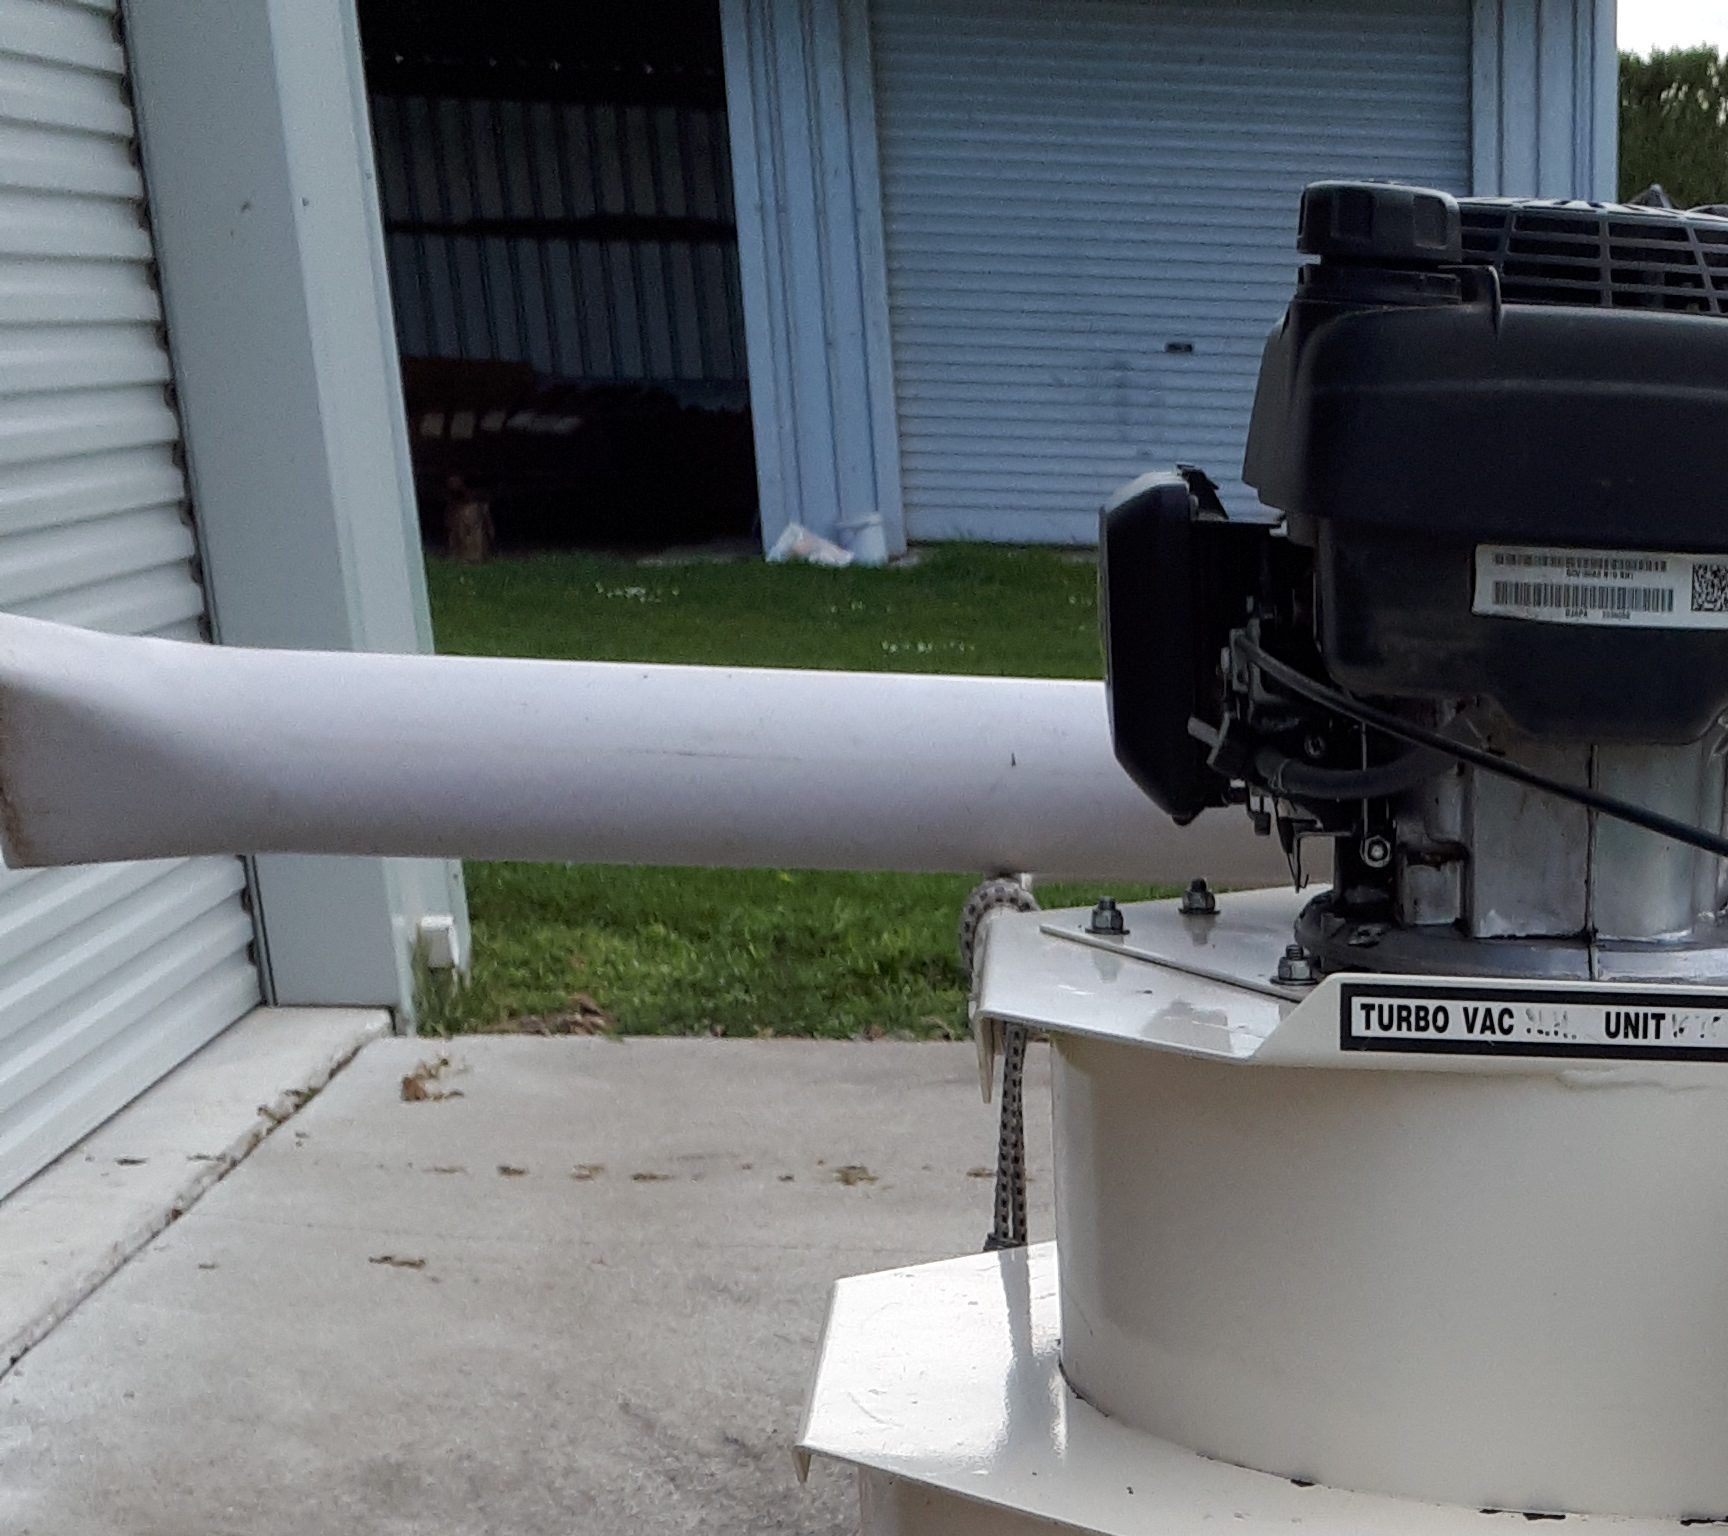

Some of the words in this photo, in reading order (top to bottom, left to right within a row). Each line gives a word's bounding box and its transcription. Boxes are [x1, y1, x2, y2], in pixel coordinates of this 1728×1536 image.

[1360, 1003, 1450, 1033] TURBO
[1463, 1007, 1515, 1035] VAC
[1604, 1011, 1666, 1040] UNIT
